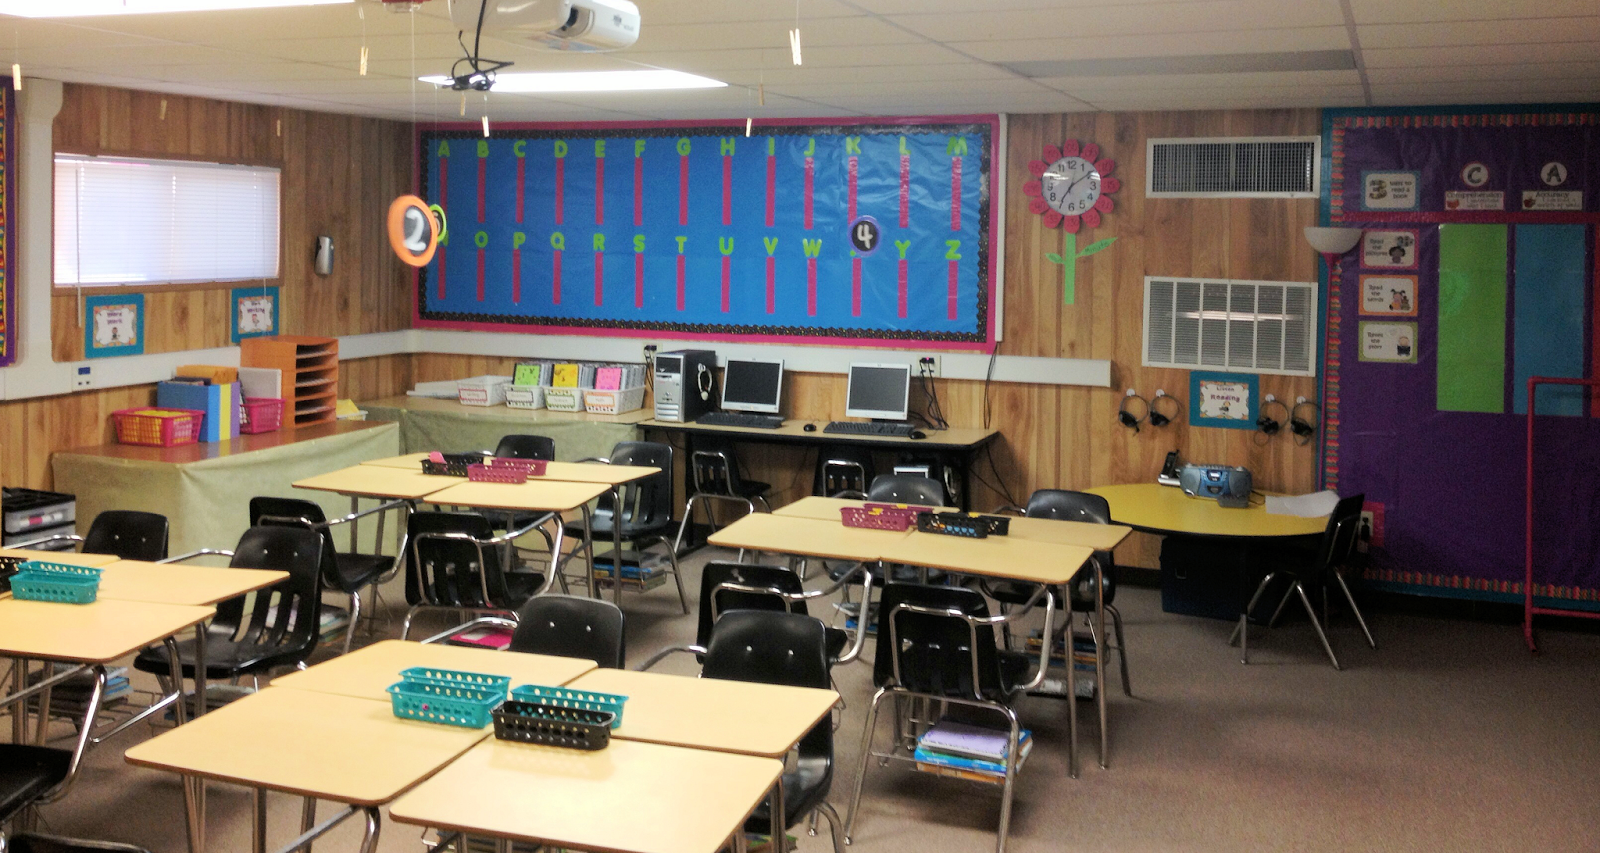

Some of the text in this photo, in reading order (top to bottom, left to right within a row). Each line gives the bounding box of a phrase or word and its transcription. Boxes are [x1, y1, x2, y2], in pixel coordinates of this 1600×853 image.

[438, 137, 967, 157] A B C D E F G H I J K L M
[1067, 160, 1076, 169] 12
[1467, 166, 1482, 183] C
[1546, 164, 1562, 182] A
[1090, 182, 1096, 190] 3
[1050, 192, 1056, 201] 8
[1068, 203, 1074, 211] 6
[1079, 200, 1085, 209] 5
[403, 207, 427, 251] 2
[856, 223, 874, 249] 4
[475, 231, 961, 259] O P Q R S T U V W Y Z
[1210, 394, 1240, 403] Reading
